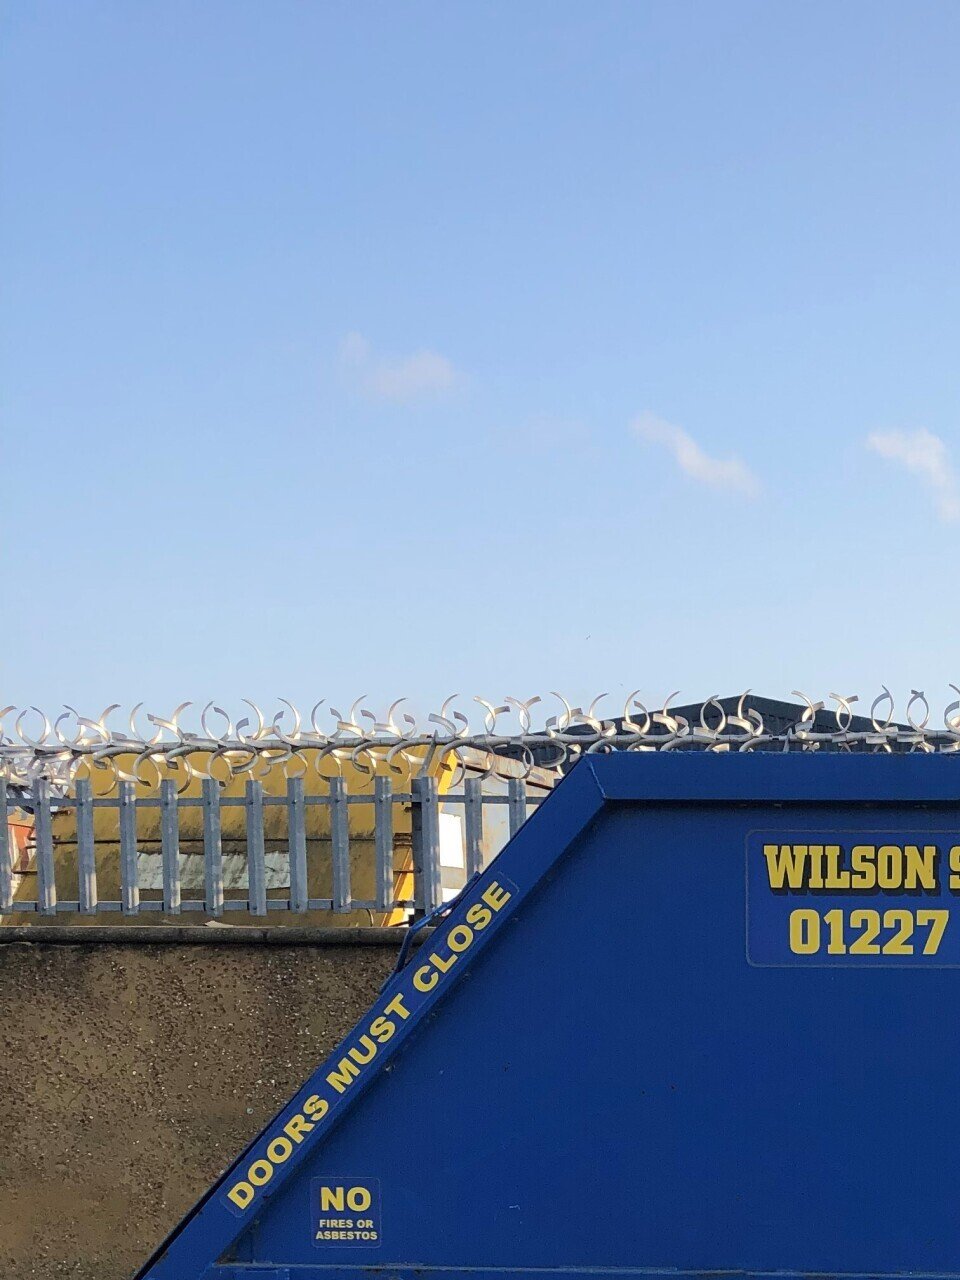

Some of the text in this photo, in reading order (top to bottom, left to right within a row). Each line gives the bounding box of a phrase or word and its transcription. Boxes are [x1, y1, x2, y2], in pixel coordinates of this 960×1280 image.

[763, 845, 937, 891] WILSON
[789, 908, 949, 955] 01227
[227, 881, 511, 1211] DOORS MUST CLOSE
[320, 1186, 371, 1212] NO
[315, 1230, 378, 1240] ASBESTOS
[319, 1219, 374, 1229] FIRES OR
